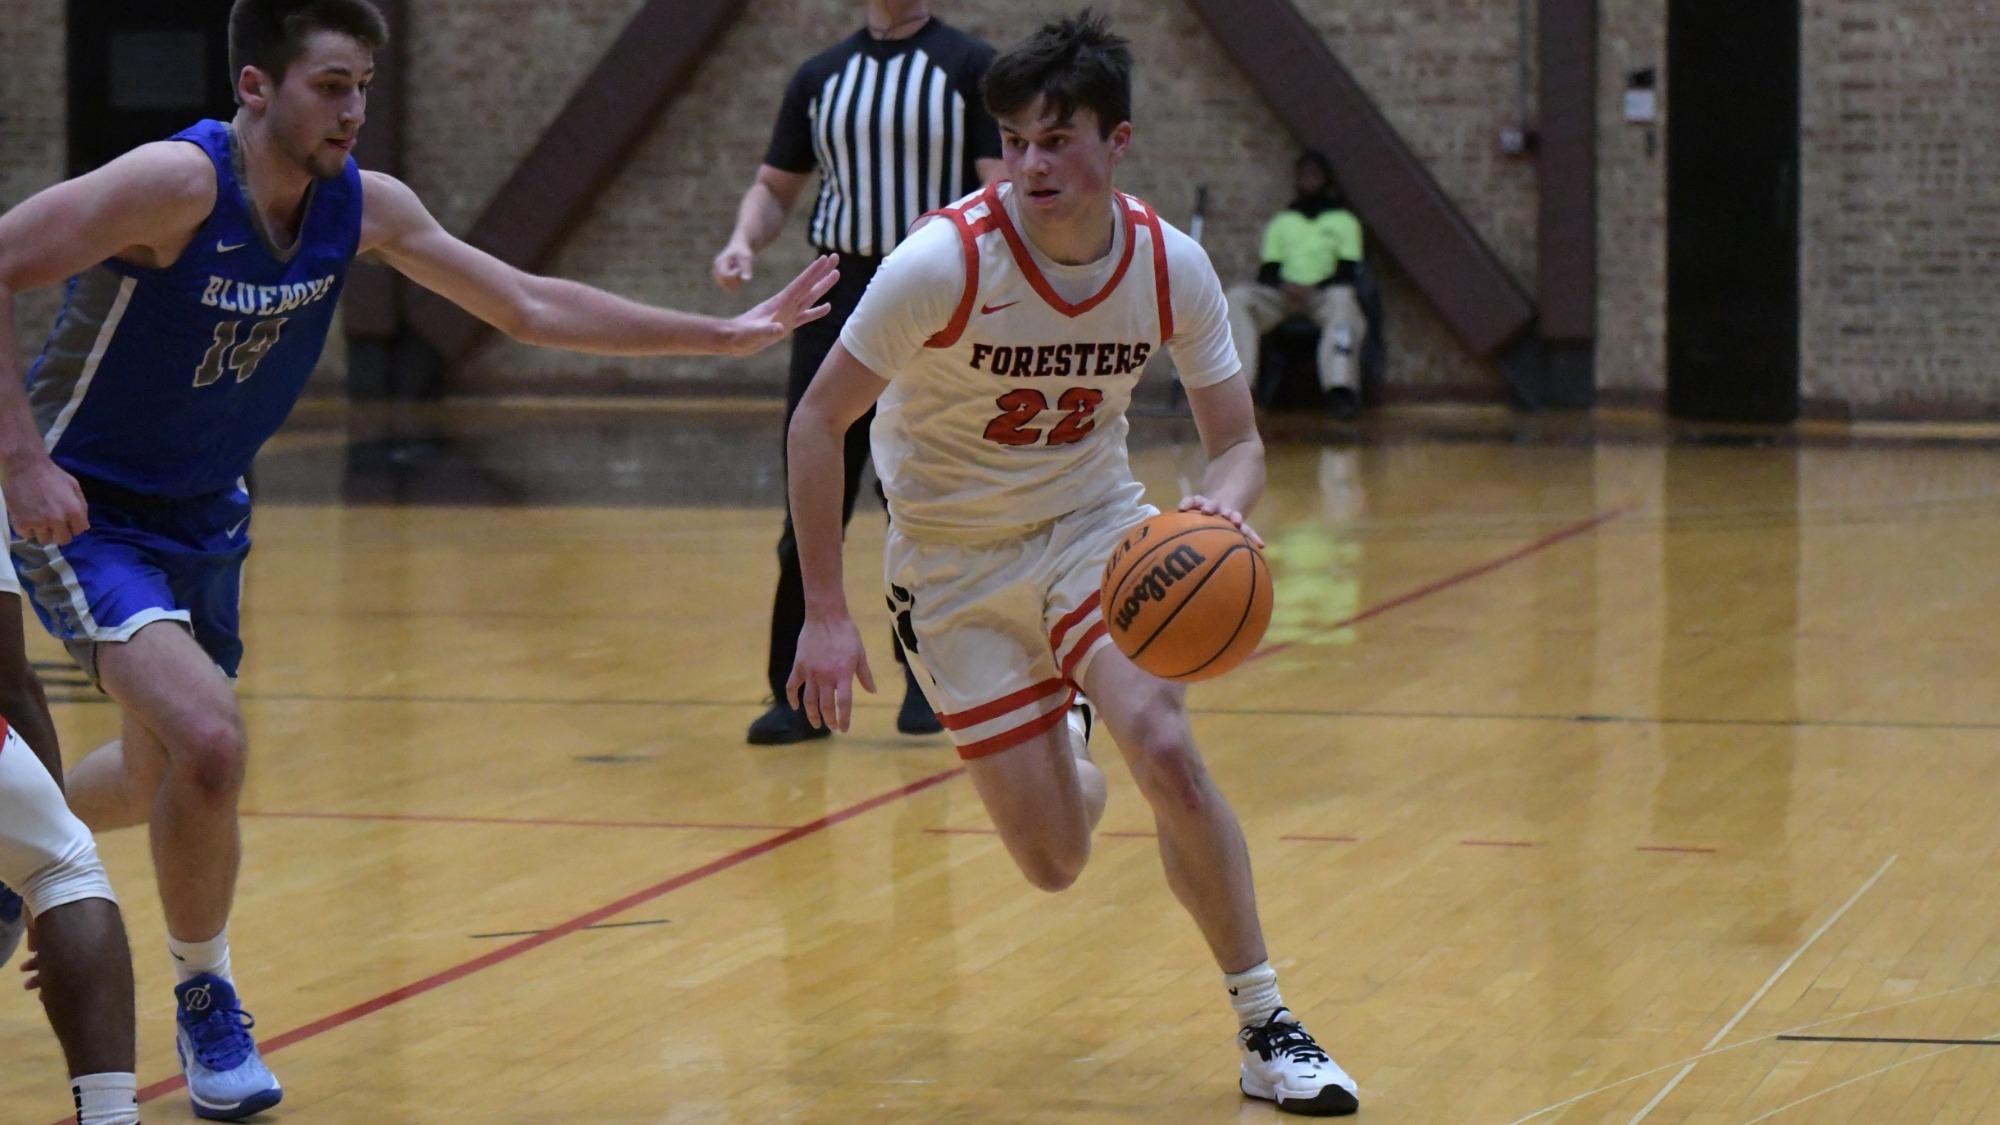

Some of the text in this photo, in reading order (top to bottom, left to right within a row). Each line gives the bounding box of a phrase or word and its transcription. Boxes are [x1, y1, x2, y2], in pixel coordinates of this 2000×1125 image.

[192, 317, 290, 388] 14
[969, 342, 1151, 377] FORESTERS
[982, 387, 1104, 446] 22
[1116, 544, 1206, 632] Wilson
